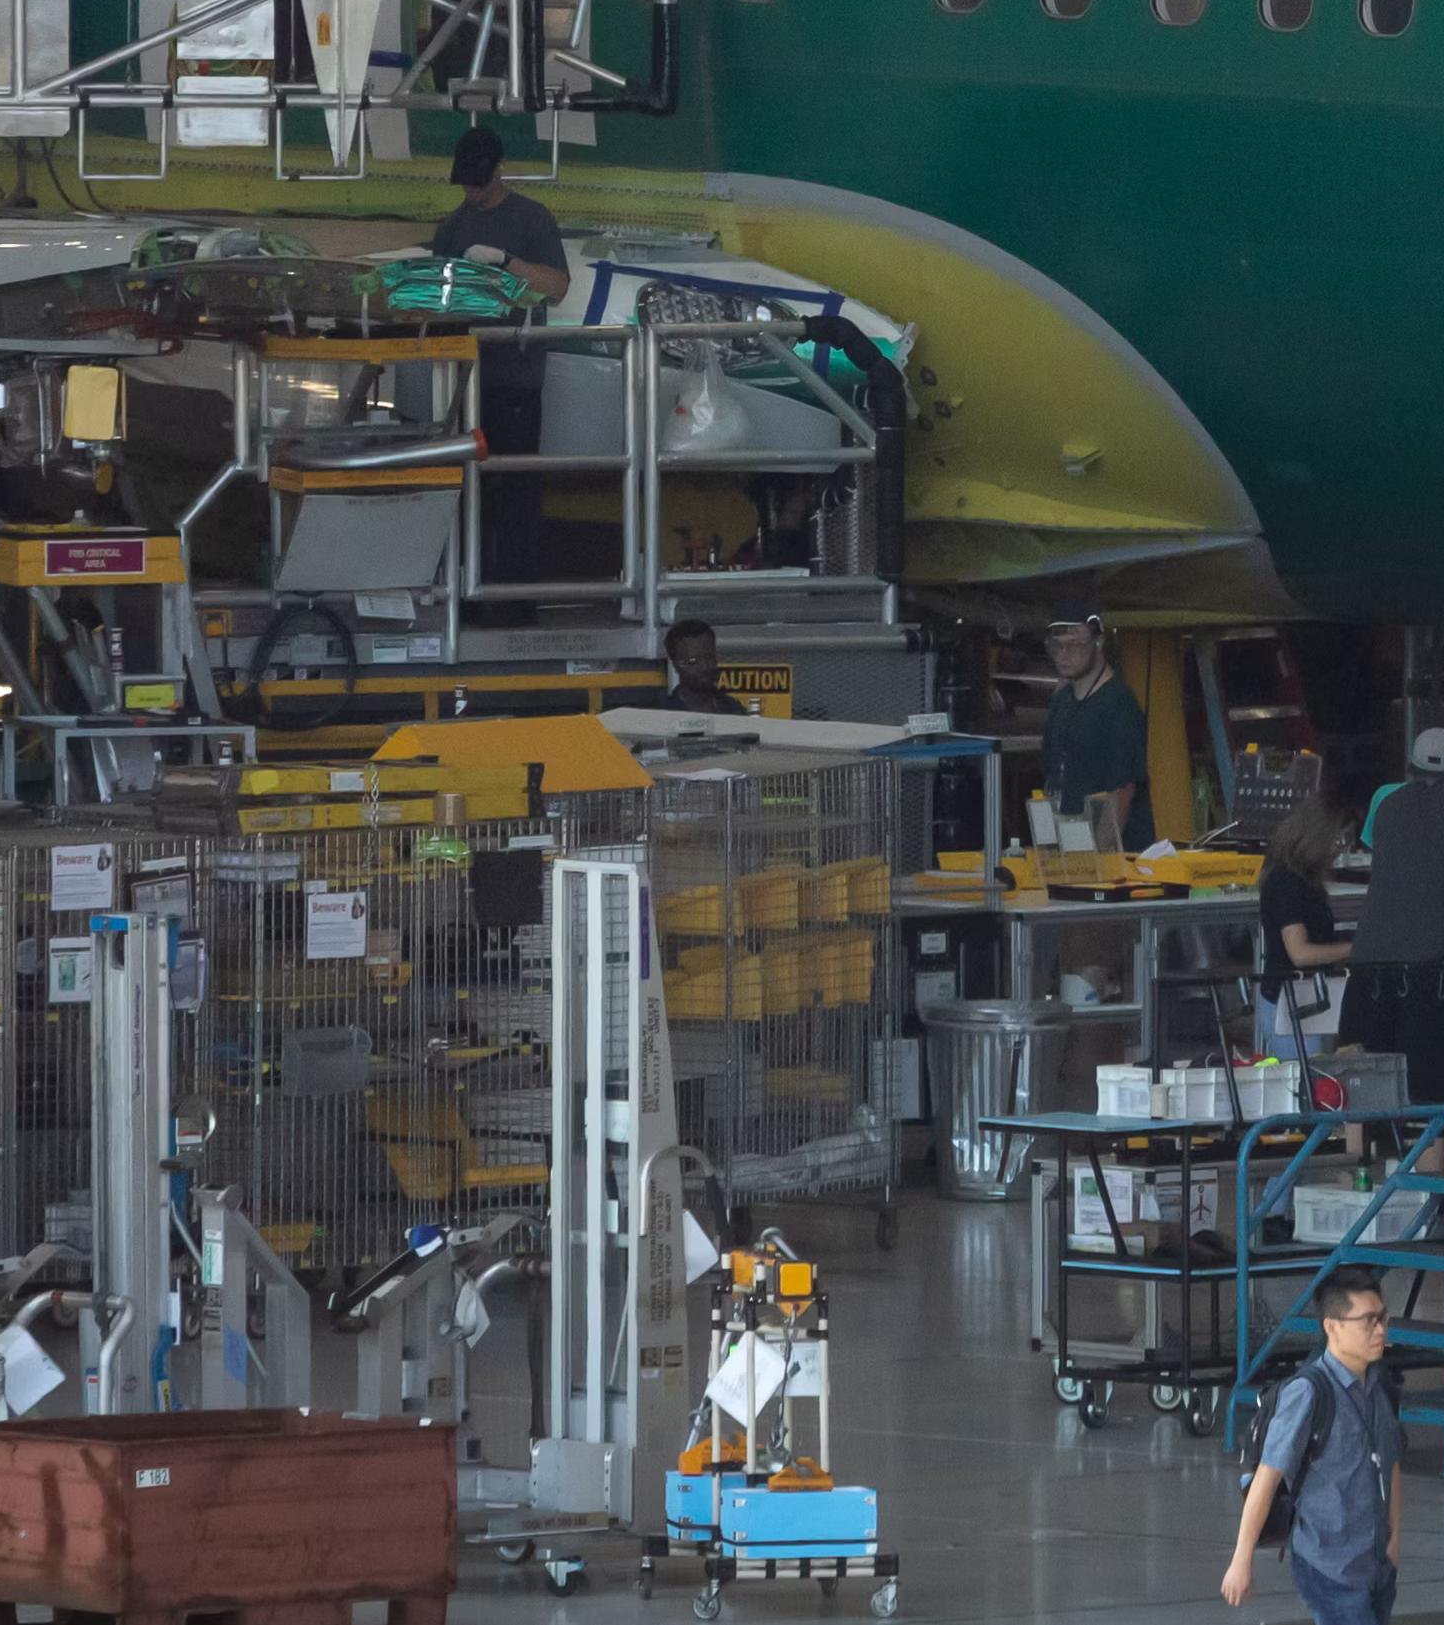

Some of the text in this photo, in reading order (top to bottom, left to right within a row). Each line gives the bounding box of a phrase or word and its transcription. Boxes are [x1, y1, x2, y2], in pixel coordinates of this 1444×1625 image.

[717, 670, 788, 690] AUTION
[56, 854, 93, 866] Beware
[312, 902, 347, 914] Beware
[150, 1469, 168, 1485] 182
